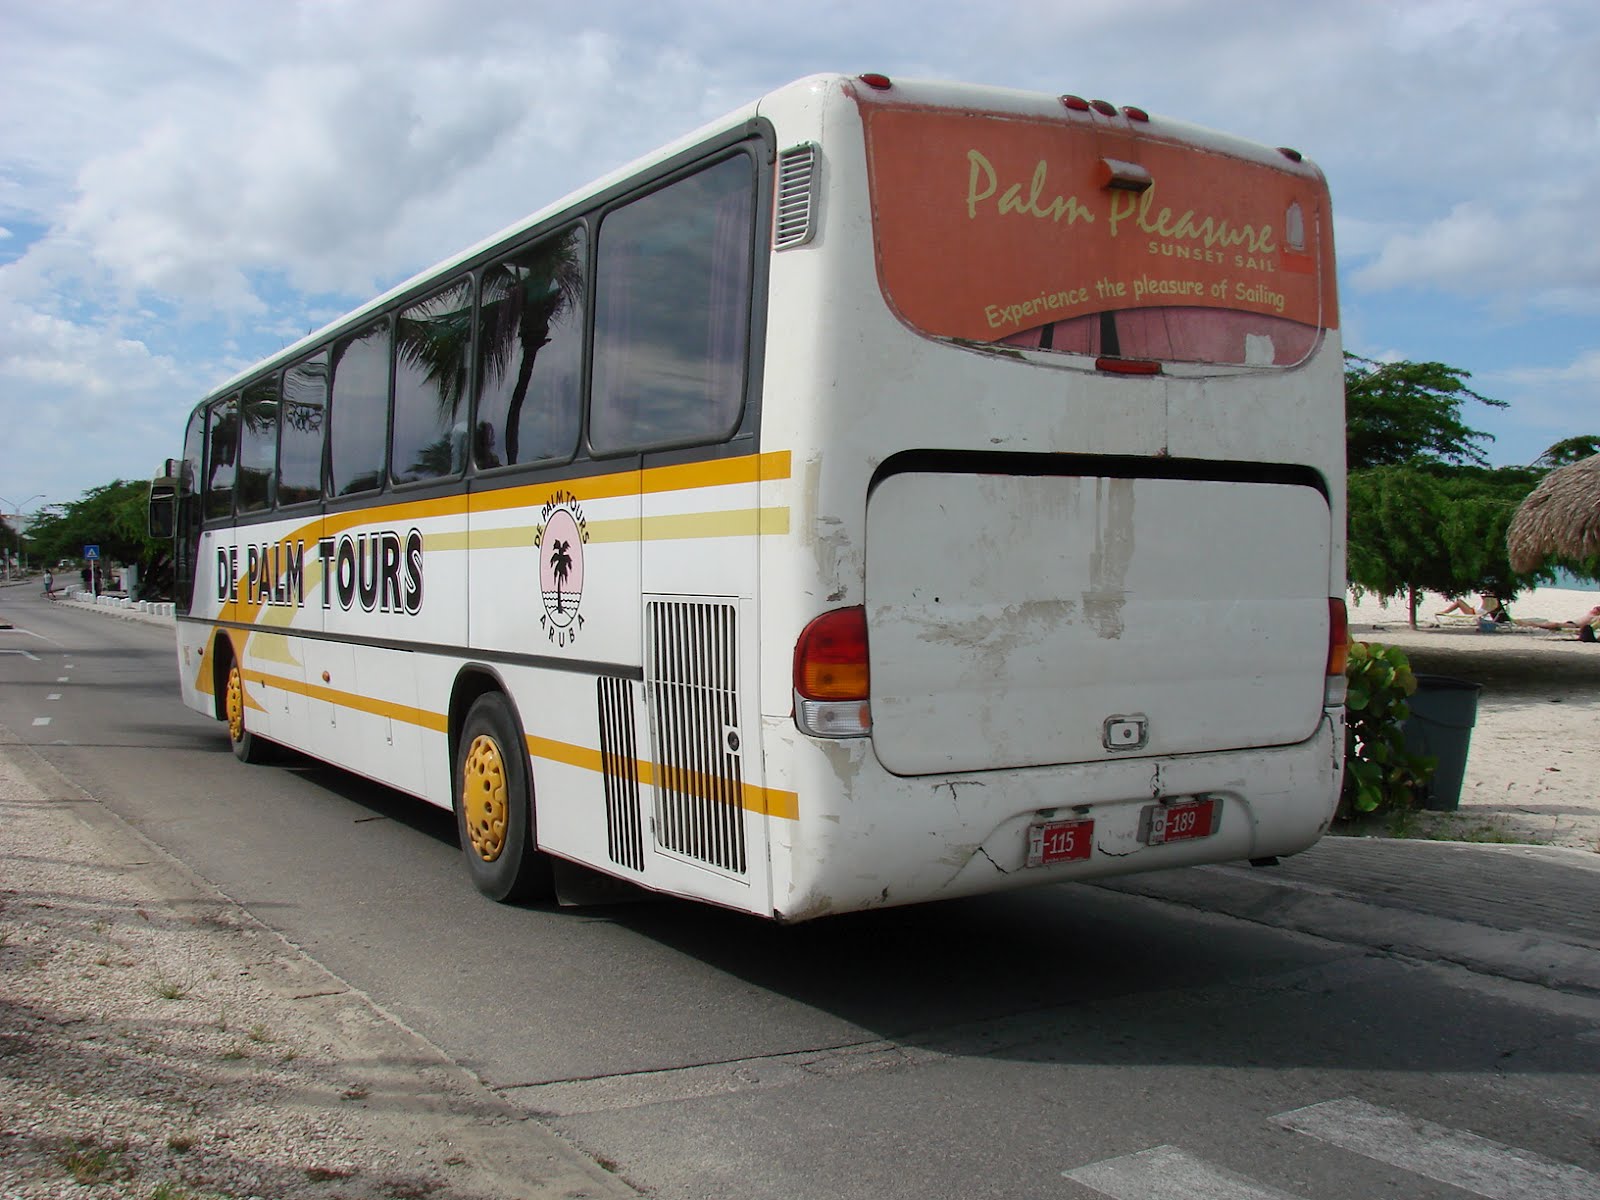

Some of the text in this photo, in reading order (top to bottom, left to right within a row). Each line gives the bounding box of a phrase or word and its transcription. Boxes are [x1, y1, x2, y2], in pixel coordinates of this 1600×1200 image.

[966, 149, 1276, 254] Palm Pleasure
[1148, 241, 1276, 273] SUNSET SAIL
[984, 273, 1285, 329] Experience the pleasure of Sailing
[533, 489, 590, 549] DE PALM TOURS
[216, 527, 425, 616] DE PALM TOURS
[539, 613, 586, 648] ARUBA
